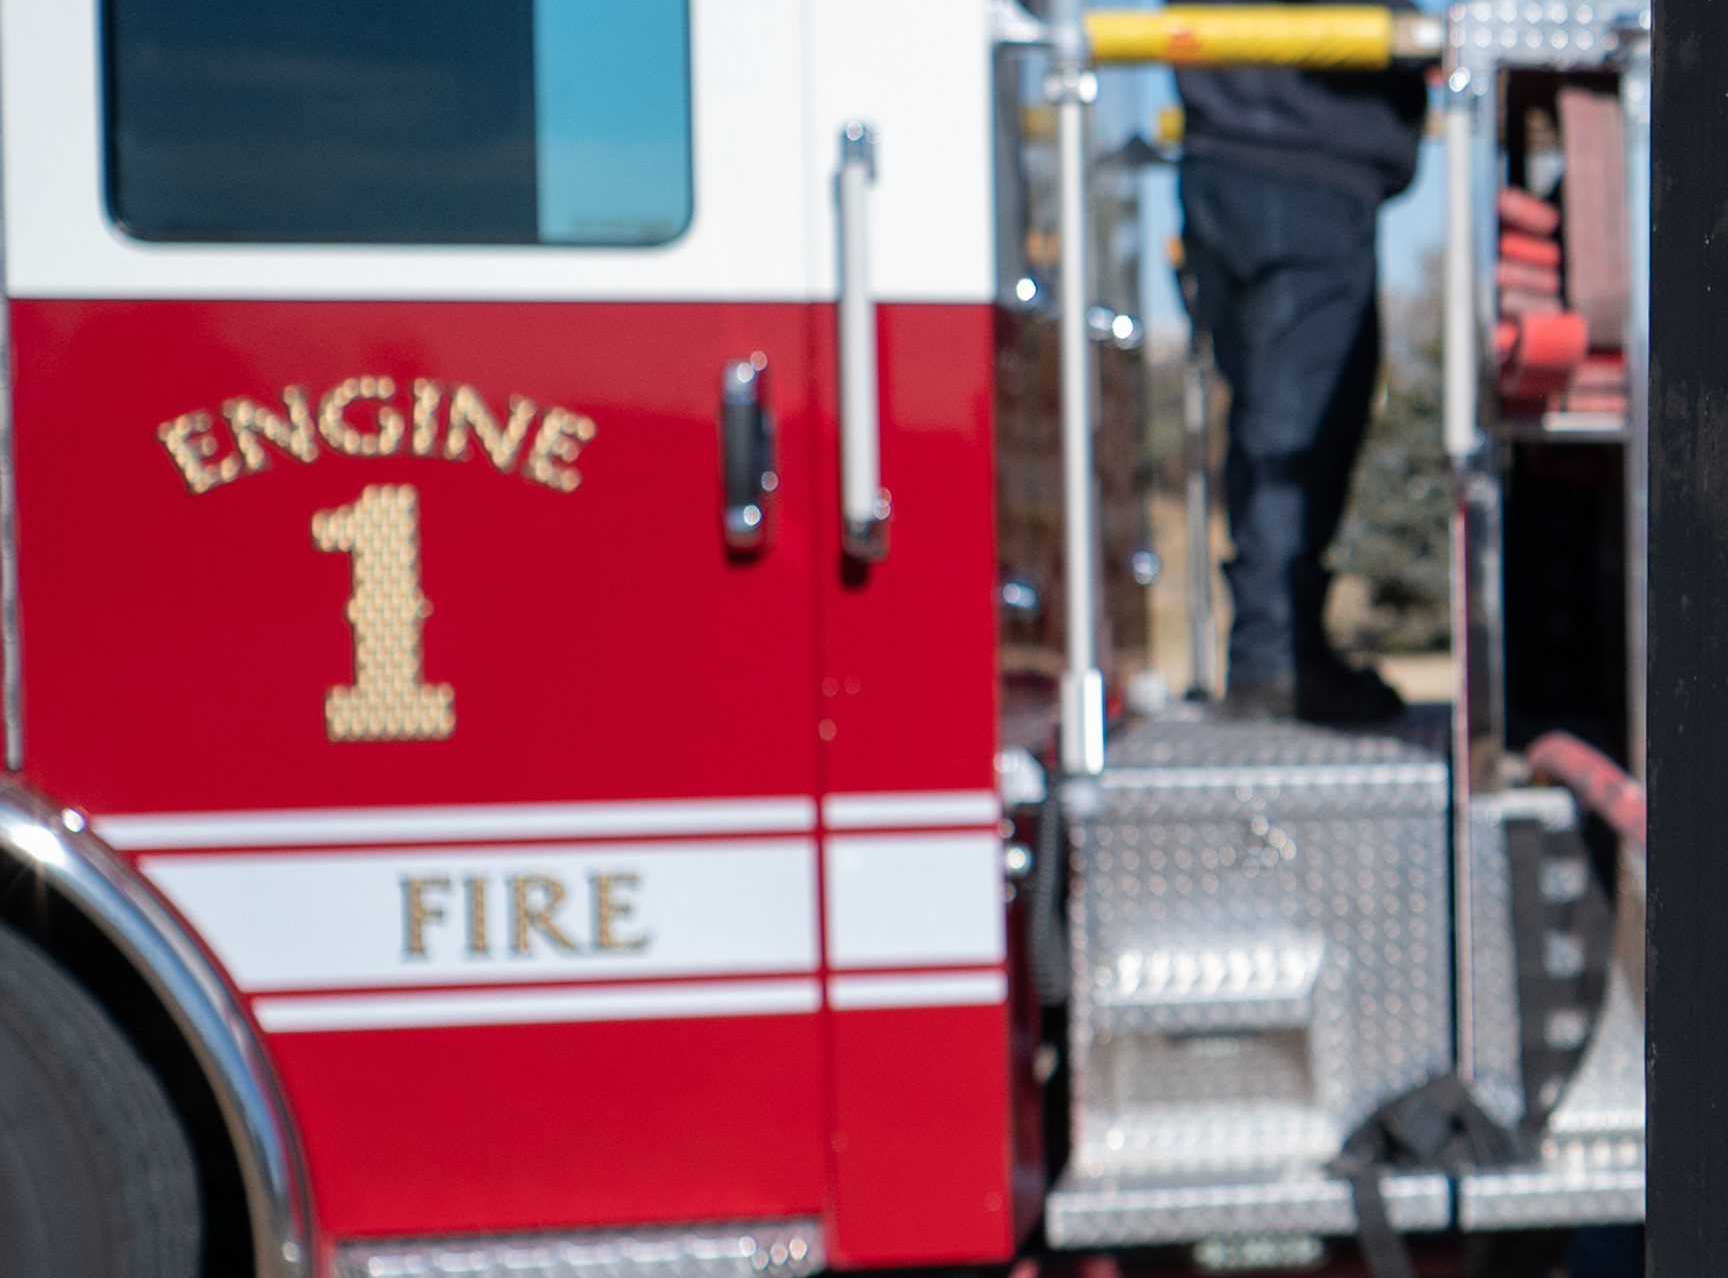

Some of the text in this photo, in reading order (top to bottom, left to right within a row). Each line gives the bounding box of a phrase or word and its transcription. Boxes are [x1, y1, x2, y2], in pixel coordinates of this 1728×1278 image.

[156, 375, 598, 495] ENGINE
[310, 484, 456, 742] 1
[398, 869, 656, 961] FIRE
